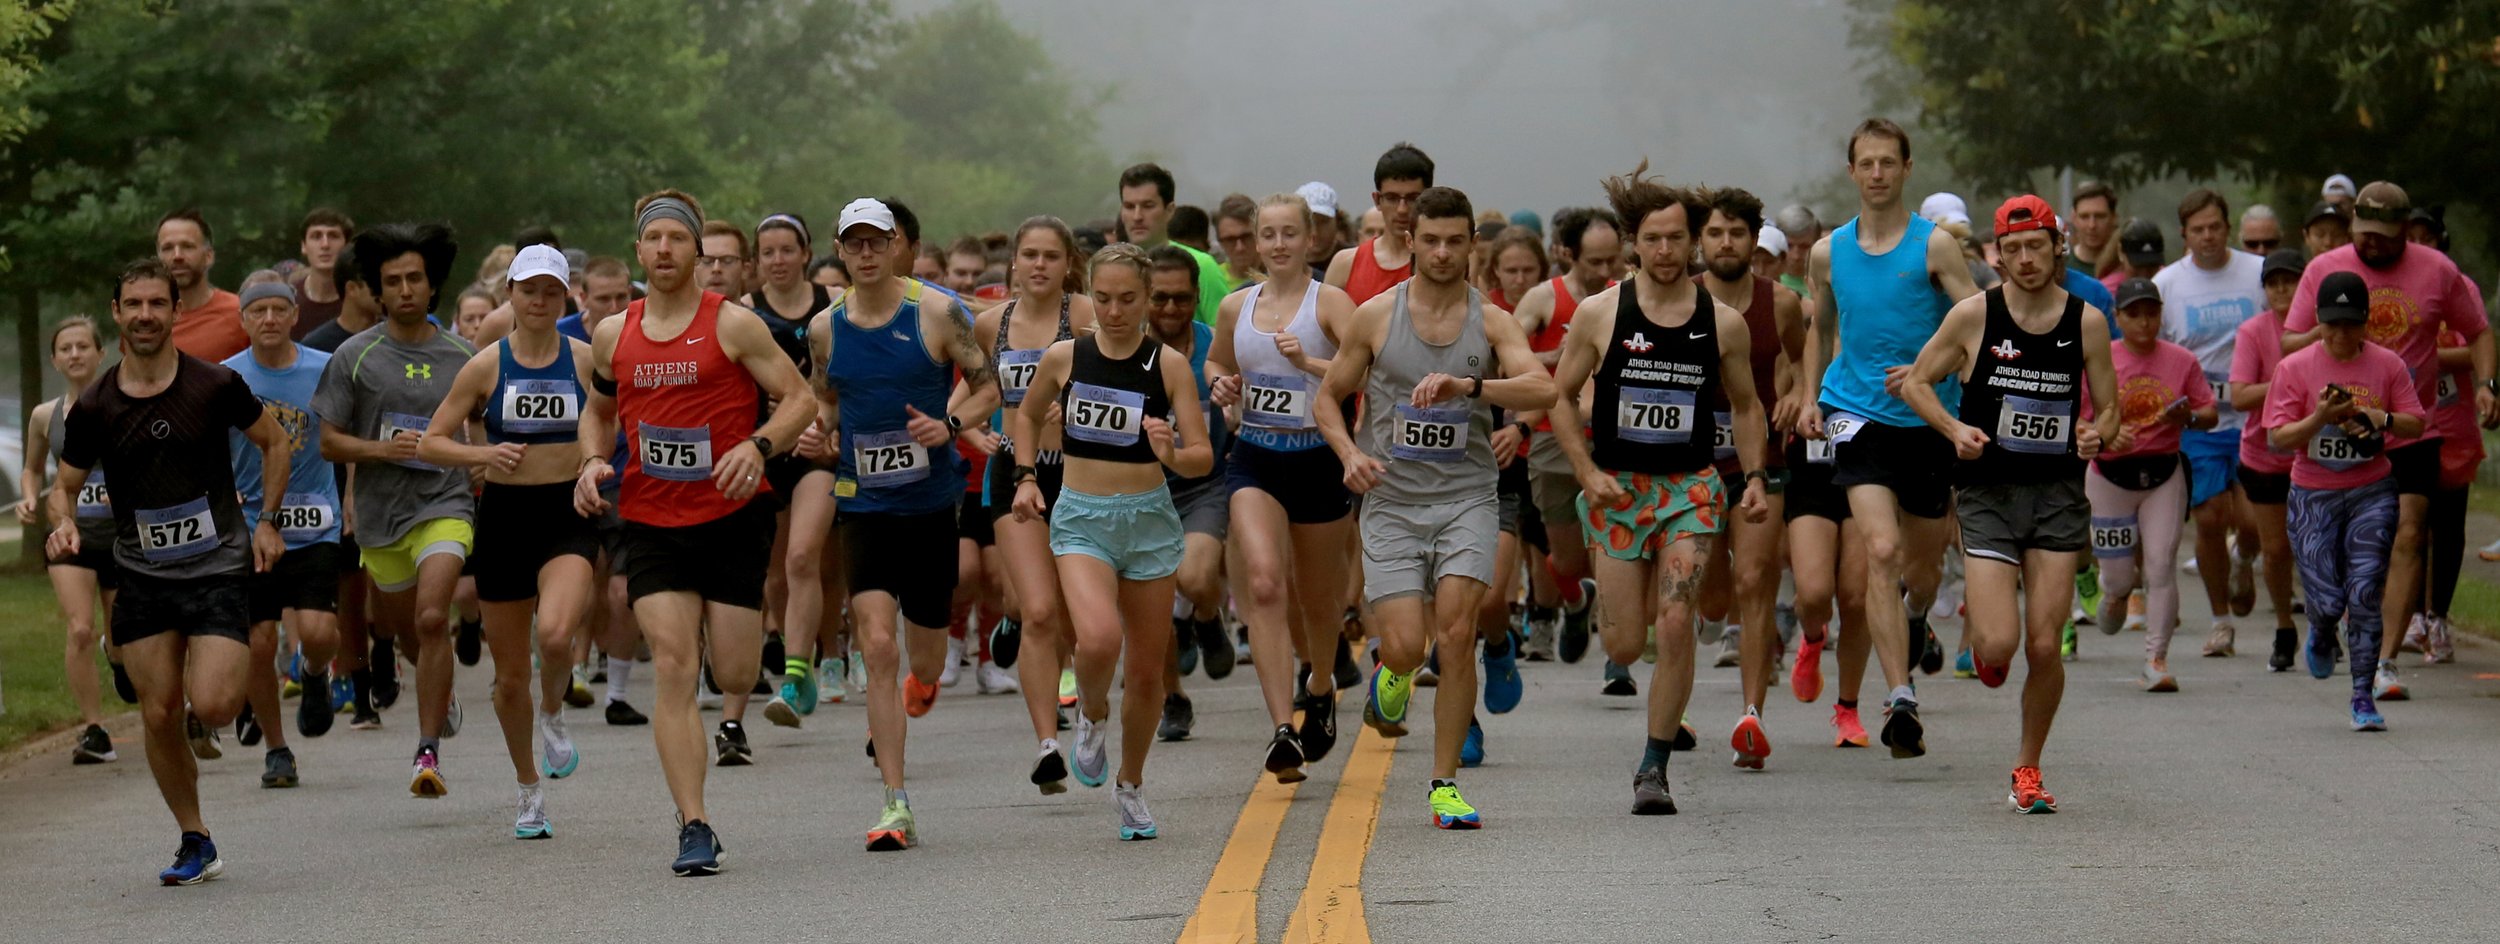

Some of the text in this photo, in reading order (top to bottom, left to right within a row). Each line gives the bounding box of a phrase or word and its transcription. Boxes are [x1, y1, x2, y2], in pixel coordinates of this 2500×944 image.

[634, 361, 697, 376] ATHENS
[1009, 365, 1037, 388] 72
[1620, 368, 1706, 385] RACING TEAM
[1628, 358, 1703, 374] ATHENS ROAD RUNNERS
[1995, 366, 2070, 382] ATHENS ROAD RUNNERS
[634, 375, 698, 388] ROAD RUNNERS
[1987, 376, 2072, 393] RACING TEAM
[516, 395, 564, 419] 620
[1251, 387, 1292, 414] 722
[1076, 400, 1127, 430] 570
[1631, 403, 1680, 430] 708
[2011, 413, 2059, 440] 556
[1242, 427, 1324, 448] PRO NIK
[1405, 422, 1455, 448] 569
[649, 441, 697, 467] 575
[865, 445, 914, 473] 725
[150, 517, 203, 547] 572
[2096, 528, 2132, 547] 668
